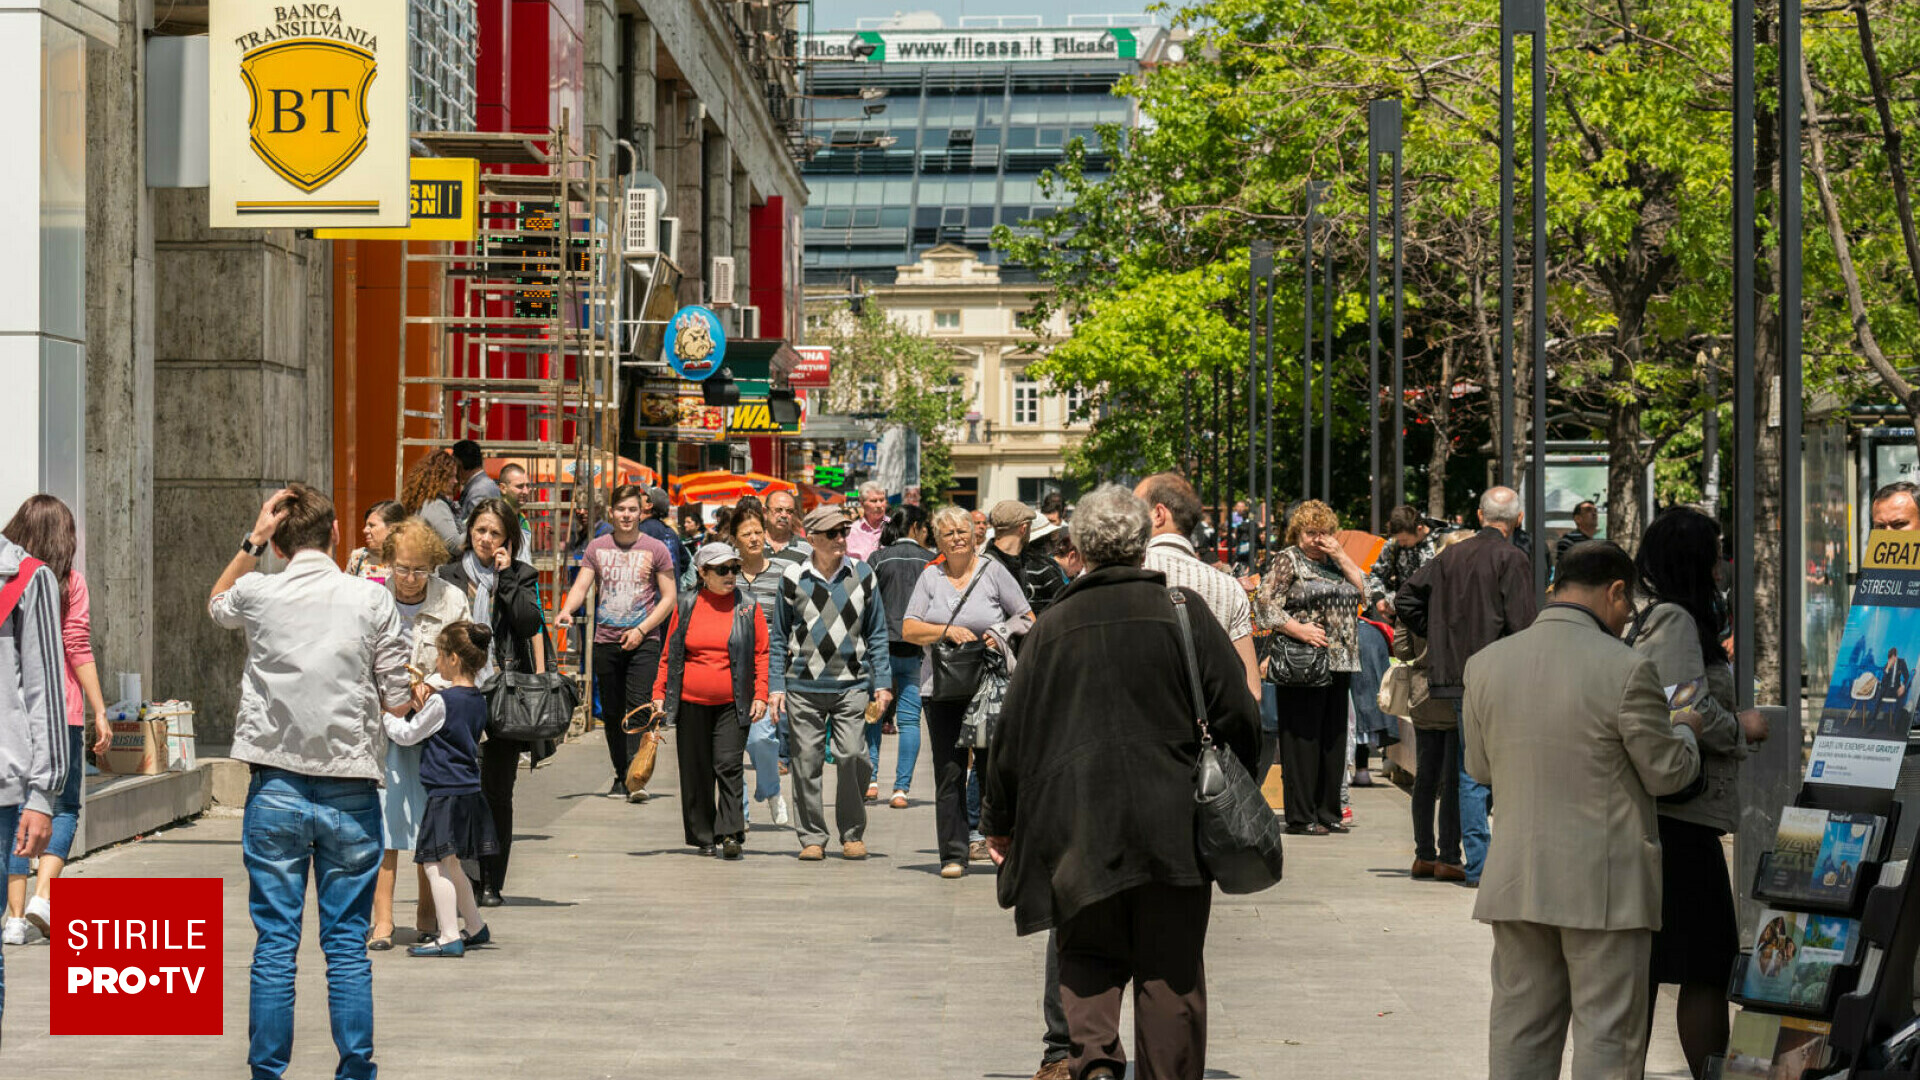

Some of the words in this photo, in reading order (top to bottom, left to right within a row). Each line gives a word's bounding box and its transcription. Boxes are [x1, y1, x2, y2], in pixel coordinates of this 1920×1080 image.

[274, 3, 343, 23] BANCA
[235, 21, 378, 52] TRANSILVANIA
[897, 36, 1042, 57] www.filcasa.it
[1053, 36, 1115, 53] Filcasa
[267, 88, 350, 133] BT
[1873, 541, 1920, 565] GRAT
[602, 566, 642, 582] COME
[1860, 578, 1903, 596] STRESUL
